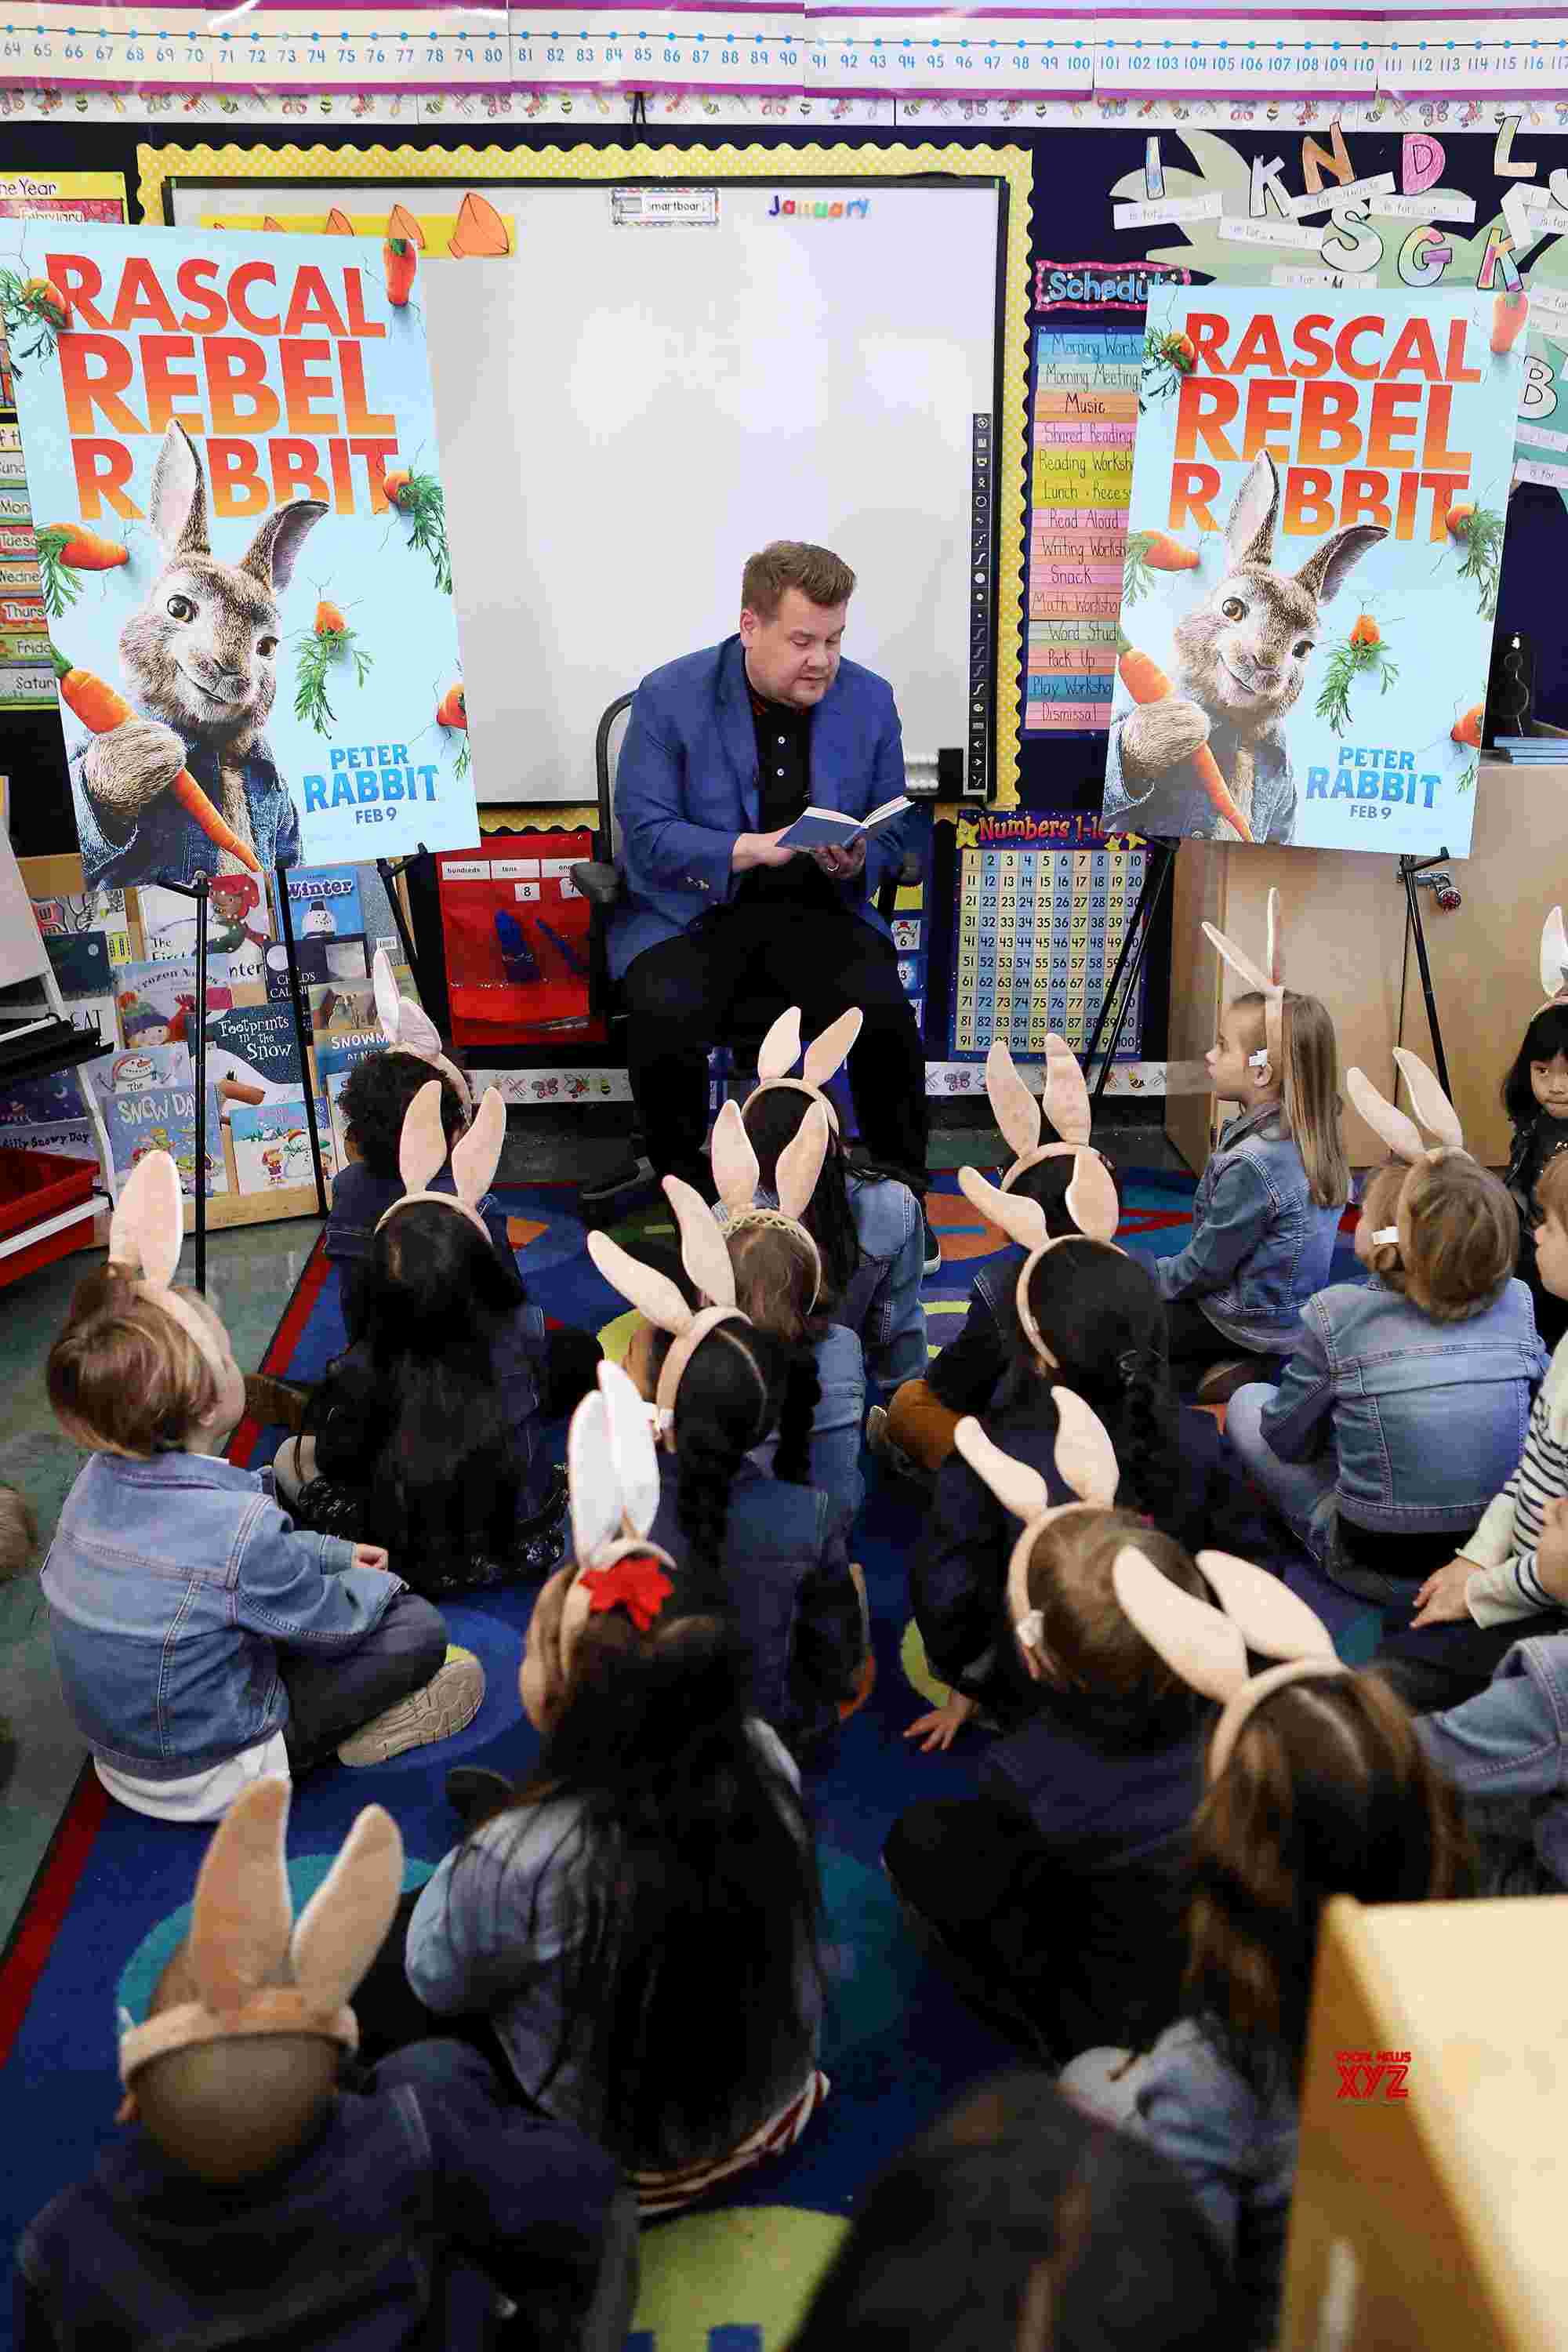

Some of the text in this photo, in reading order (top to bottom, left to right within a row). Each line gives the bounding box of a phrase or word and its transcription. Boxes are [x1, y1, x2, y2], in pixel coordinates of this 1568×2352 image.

[307, 50, 326, 63] 74
[337, 50, 357, 63] 75
[366, 50, 385, 64] 76
[395, 49, 414, 63] 77
[426, 49, 445, 63] 78
[455, 49, 474, 63] 79
[483, 49, 503, 63] 80
[517, 48, 533, 62] 81
[546, 48, 565, 63] 82
[576, 48, 595, 63] 83
[604, 48, 623, 63] 84
[633, 48, 652, 63] 85
[662, 49, 681, 63] 86
[691, 49, 710, 64] 87
[721, 50, 739, 64] 88
[750, 50, 769, 65] 89
[778, 52, 797, 67] 90
[19, 176, 56, 195] Year
[45, 252, 387, 338] RASCAL
[1049, 271, 1161, 303] Schedu
[1184, 313, 1482, 383] RASCAL
[58, 332, 396, 435] REBEL
[1065, 393, 1105, 414] Music
[1174, 377, 1472, 470] REBEL
[71, 437, 398, 521] RBBIT
[1044, 479, 1078, 500] Lunch
[1169, 462, 1471, 543] RBBIT
[1048, 508, 1119, 528] Read Aloud
[1051, 564, 1092, 583] Snack
[1048, 648, 1097, 674] Pack Up
[1042, 702, 1096, 721] Dismissal
[330, 744, 409, 770] PETER
[1339, 746, 1416, 771] PETER
[303, 765, 439, 814] RABBIT
[1305, 766, 1442, 808] RABBIT
[355, 807, 397, 824] FEB 9
[1350, 805, 1392, 819] FEB 9
[978, 816, 1070, 840] Numbers
[987, 855, 995, 866] 2
[1007, 855, 1014, 866] 3
[1024, 855, 1032, 866] 4
[1042, 855, 1050, 866] 5
[1061, 855, 1068, 866] 6
[1079, 855, 1086, 866] 7
[1097, 855, 1104, 866] 8
[1115, 855, 1122, 866] 9
[1131, 855, 1142, 866] 10
[289, 879, 353, 898] Winter
[967, 876, 1142, 887] 11 12 13 14 15 16 17 18 19 20
[524, 887, 532, 897] 8
[900, 937, 907, 947] 6
[964, 956, 1102, 969] 51 52 53 54 55 56 57 58
[218, 1016, 289, 1036] Footprints
[258, 1033, 275, 1043] the
[960, 1036, 1045, 1047] 91 92 94 95
[247, 1043, 292, 1060] Snow
